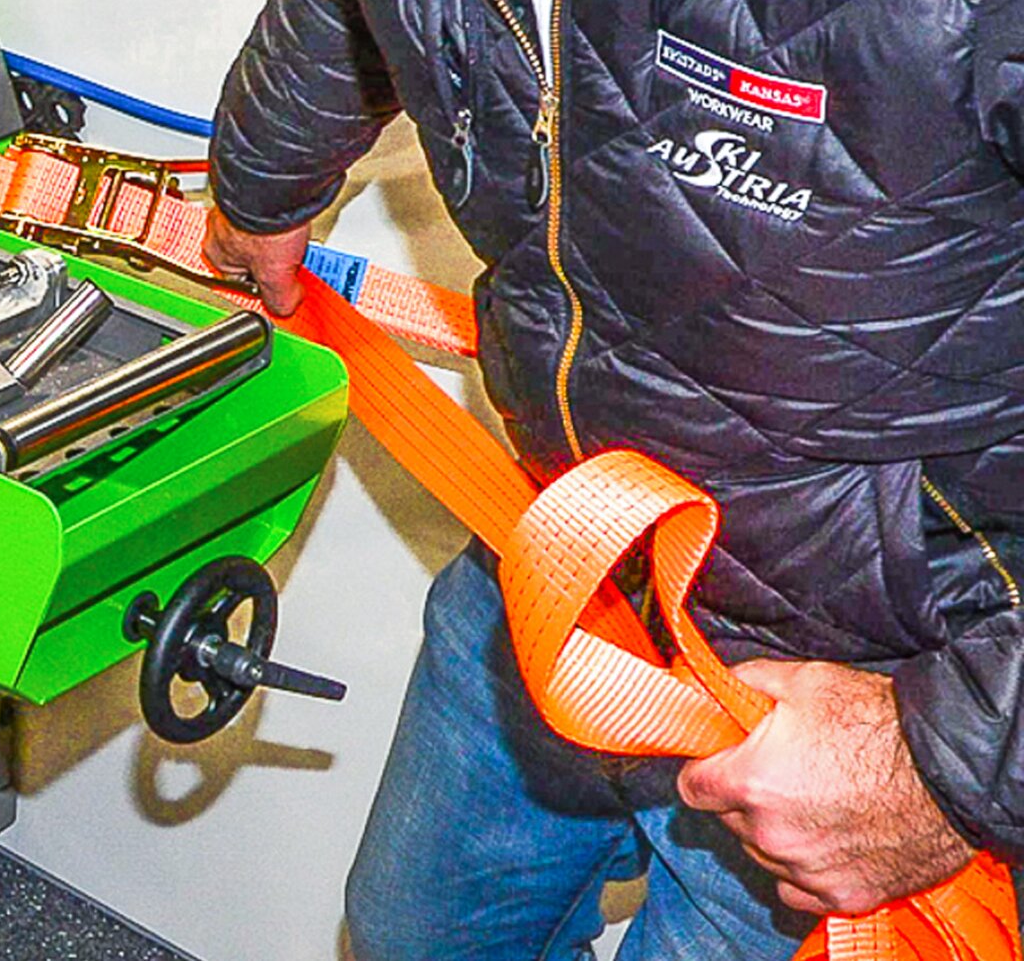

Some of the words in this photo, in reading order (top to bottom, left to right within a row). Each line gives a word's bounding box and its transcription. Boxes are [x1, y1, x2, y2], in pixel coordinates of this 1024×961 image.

[687, 87, 774, 133] WORKWEAR
[646, 130, 812, 211] AUSTRIA
[673, 130, 761, 187] SKI
